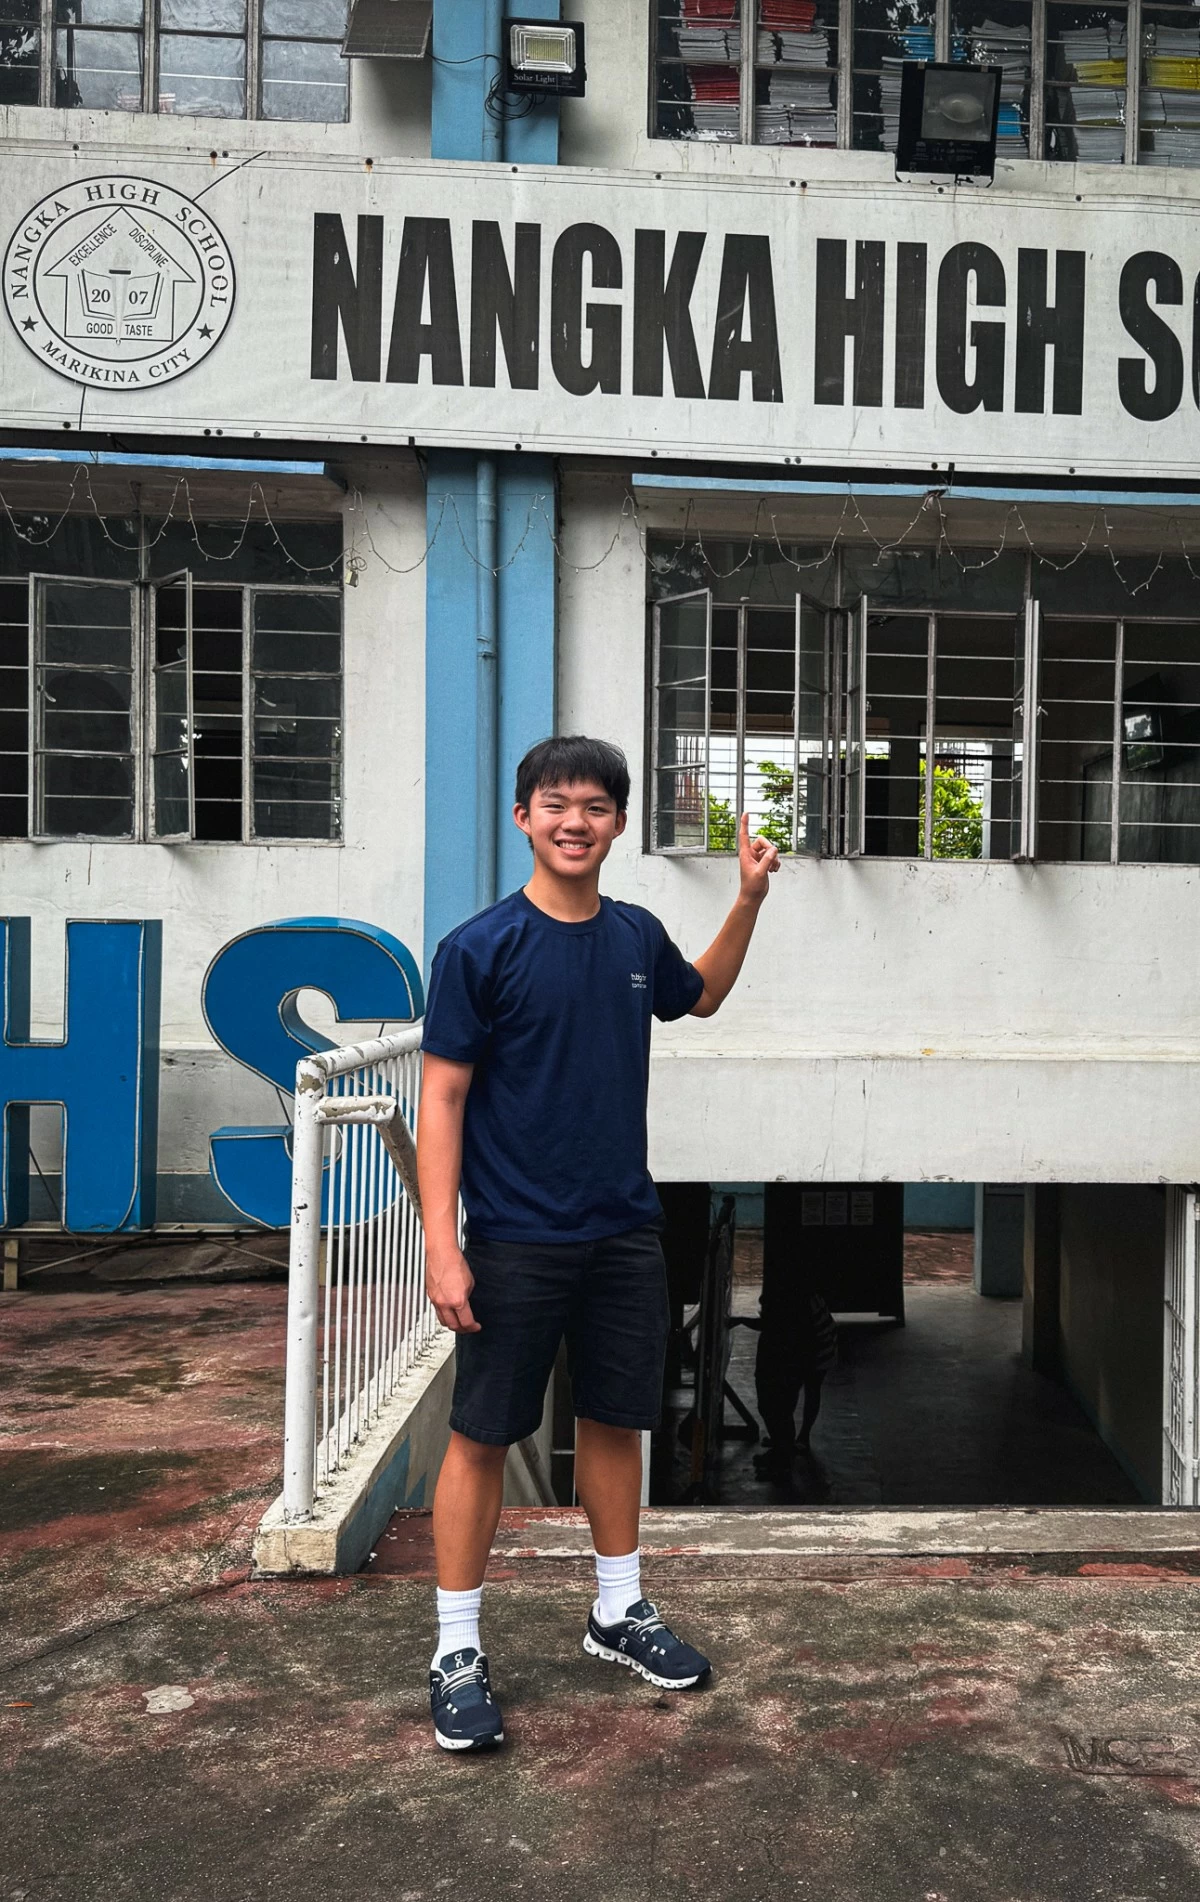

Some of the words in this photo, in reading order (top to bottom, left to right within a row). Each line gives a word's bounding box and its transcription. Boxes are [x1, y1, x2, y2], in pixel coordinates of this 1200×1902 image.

[513, 73, 533, 81] Solar
[535, 74, 556, 84] Light
[11, 200, 71, 300] NANGKA
[84, 183, 161, 206] HIGH
[175, 207, 229, 308] SCHOOL
[68, 223, 118, 267] EXCELLENCE
[128, 228, 169, 268] DISCIPLINE
[91, 289, 111, 303] 20
[128, 291, 149, 305] 07
[310, 212, 784, 404] NANGKA
[814, 237, 1086, 416] HIGH
[1118, 250, 1200, 422] S
[86, 323, 113, 335] GOOD
[125, 324, 153, 336] TASTE
[41, 341, 141, 383] MARIKINA
[149, 348, 192, 378] CITY
